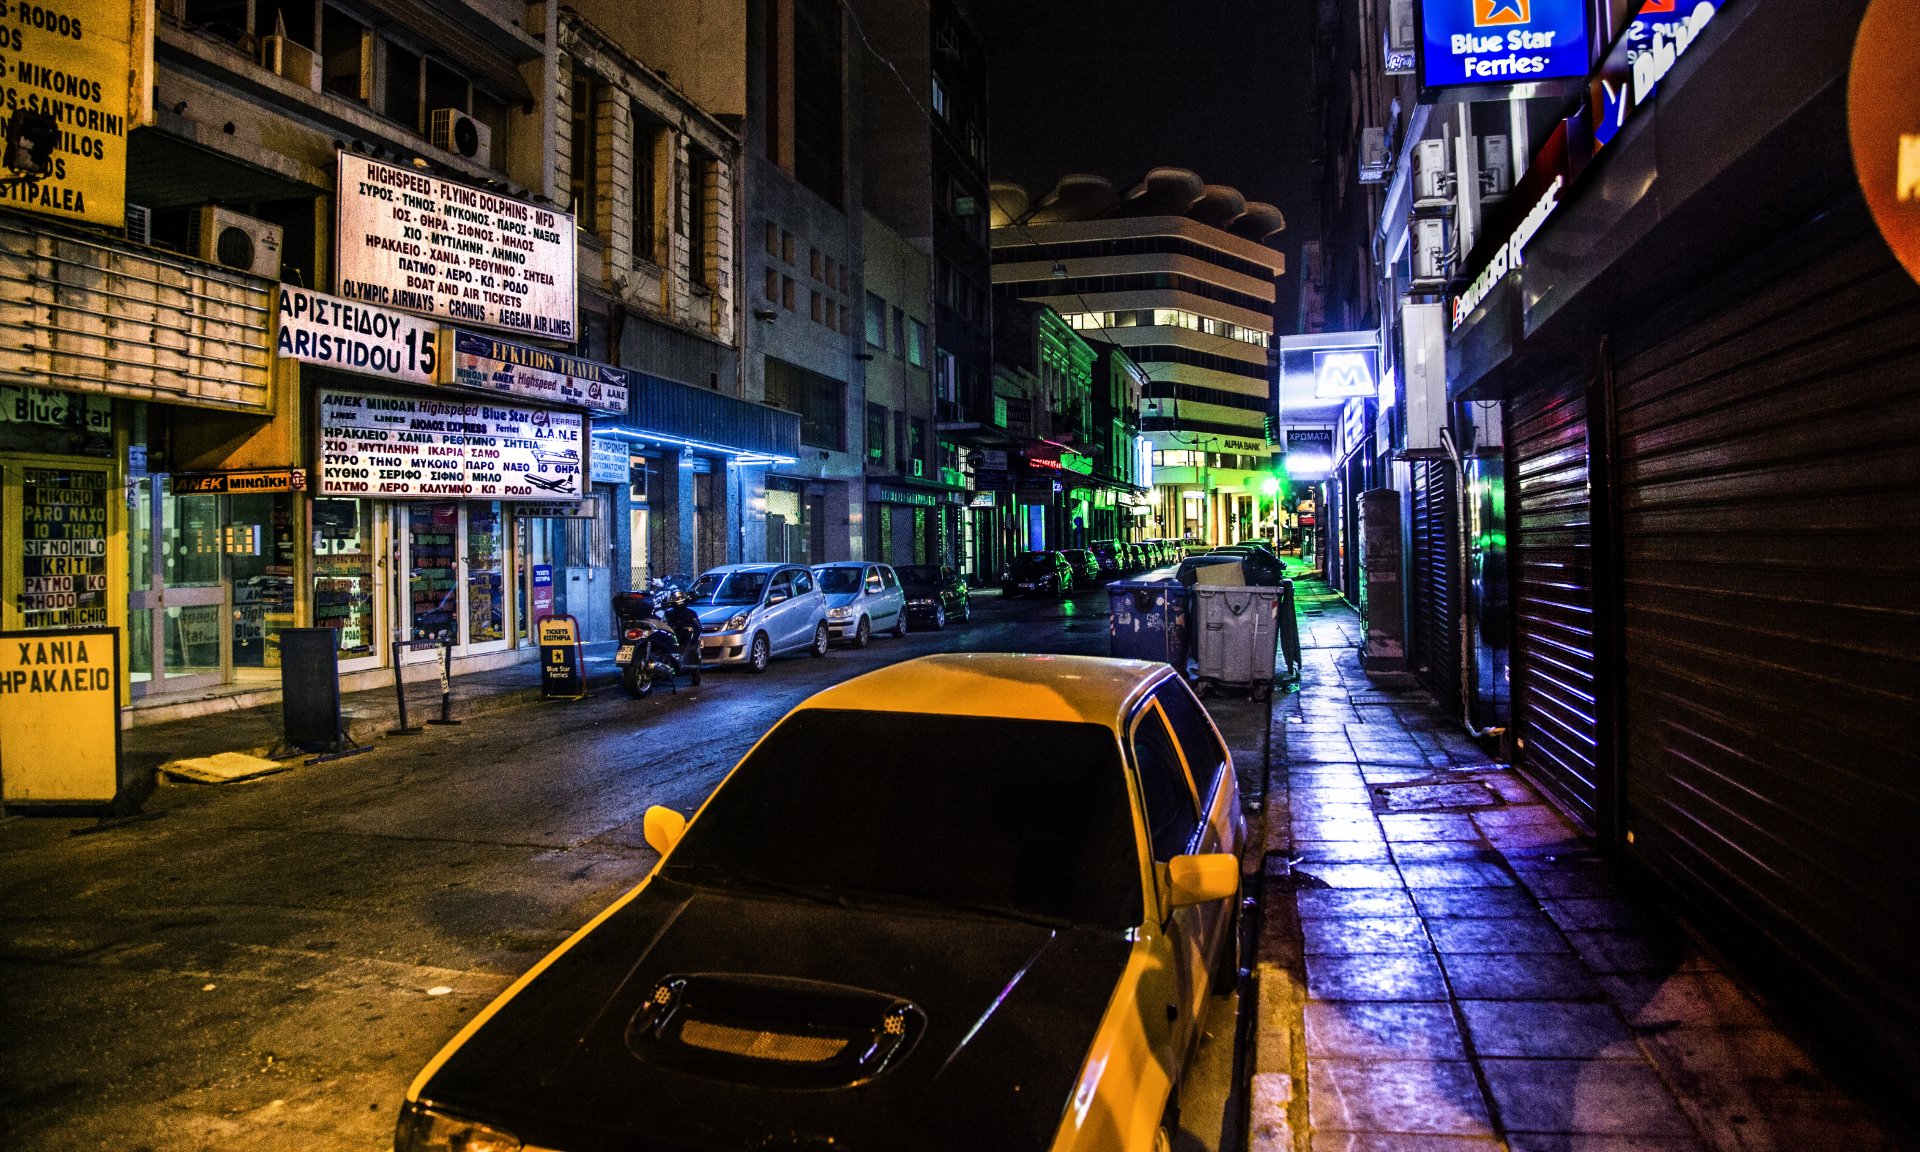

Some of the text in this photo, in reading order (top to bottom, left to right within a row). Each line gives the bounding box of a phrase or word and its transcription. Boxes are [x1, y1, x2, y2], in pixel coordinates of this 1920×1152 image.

[20, 2, 82, 40] RODOS
[1451, 29, 1556, 55] Blue Star
[1464, 53, 1545, 78] Ferries
[19, 61, 101, 103] MIKONOS
[29, 93, 123, 137] SANTORINI
[367, 163, 555, 228] HIGHSPEED FLYING DOLPHINS MFD
[359, 182, 561, 245] ΣΥΡΟΣ ΤΗΝΟΣ ΜΥΚΟΝΟΣ ΠΑΡΟΣ ΝΑΞΟΣ
[393, 207, 535, 252] ΙΟΣ ΘΗΡΑ ΣΙΦΝΟΣ ΜΗΛΟΣ
[403, 225, 526, 265] ΧΙΟ ΜΥΤΙΛΗΝΗ ΛΗΜΝΟ
[366, 233, 555, 287] ΗΡΑΚΛΕΙΟ ΧΑΝΙΑ ΡΕΘΥΜΝΟ ΣΗΤΕΙΑ
[398, 257, 529, 295] ΠΑΤΜΟ ΛΕΡΟ ΚΩ ΡΟΔΟ
[407, 275, 522, 309] BOAT AND AIR TICKETS
[344, 279, 571, 337] OLYMPIC AIRWAYS CRONUS AEGEAN AIR LINES
[280, 288, 436, 374] ΑΡΙΣΤΕΙΔΟΥ 15
[277, 325, 400, 374] ARISTIDOU
[492, 341, 555, 371] EFKLIDIS
[518, 372, 557, 391] Highspeed
[15, 398, 64, 423] Blue
[323, 395, 362, 407] ANEK
[367, 398, 415, 412] MINOAN
[419, 401, 478, 417] Highspeed
[483, 407, 506, 420] Blue
[509, 410, 529, 423] Star
[551, 417, 580, 426] FERRIES
[331, 411, 357, 420] LINES
[374, 415, 405, 423] LINES
[447, 422, 487, 434] EXPRESS
[496, 424, 519, 433] Ferries
[324, 427, 539, 449] ΗΡΑΚΛΕΙΟ ΧΑΝΙΑ ΡΕΘΥΜΝΟ ΣΗΤΕΙΑ
[1224, 440, 1260, 451] ALPHA BANK
[1289, 432, 1330, 441] ΧΡΩΜΑΤΑ
[325, 441, 500, 458] ΧΙΟ ΜΥΤΙΛΗΝΗ ΙΚΑΡΙΑ ΣΑΜΟ
[324, 455, 580, 474] ΣΥΡΟ ΤΗΝΟ ΜΥΚΟΝΟ ΠΑΡΟ ΝΑΞΟ ΙΟ ΘΗΡΑ
[324, 467, 502, 482] ΚΥΘΝΟ ΣΕΡΙΦΟ ΣΙΦΝΟ ΜΗΛΟ
[175, 477, 224, 490] ANEK
[230, 477, 287, 489] ΜΙΝΩΪΚΗ
[324, 481, 532, 495] ΠΑΤΜΟ ΛΕΡΟ ΚΑΛΥΜΝΟ ΚΩ ΡΟΔΟ
[25, 506, 105, 522] PARO NAXO
[62, 524, 104, 539] THIRA
[25, 541, 105, 554] SIFNO MILO
[44, 558, 90, 574] KRITI
[25, 576, 106, 592] PATMO KO
[26, 593, 75, 609] RHODO
[80, 608, 106, 623] CHIO
[19, 641, 89, 666] ΧΑΝΙΑ
[560, 665, 571, 673] Star
